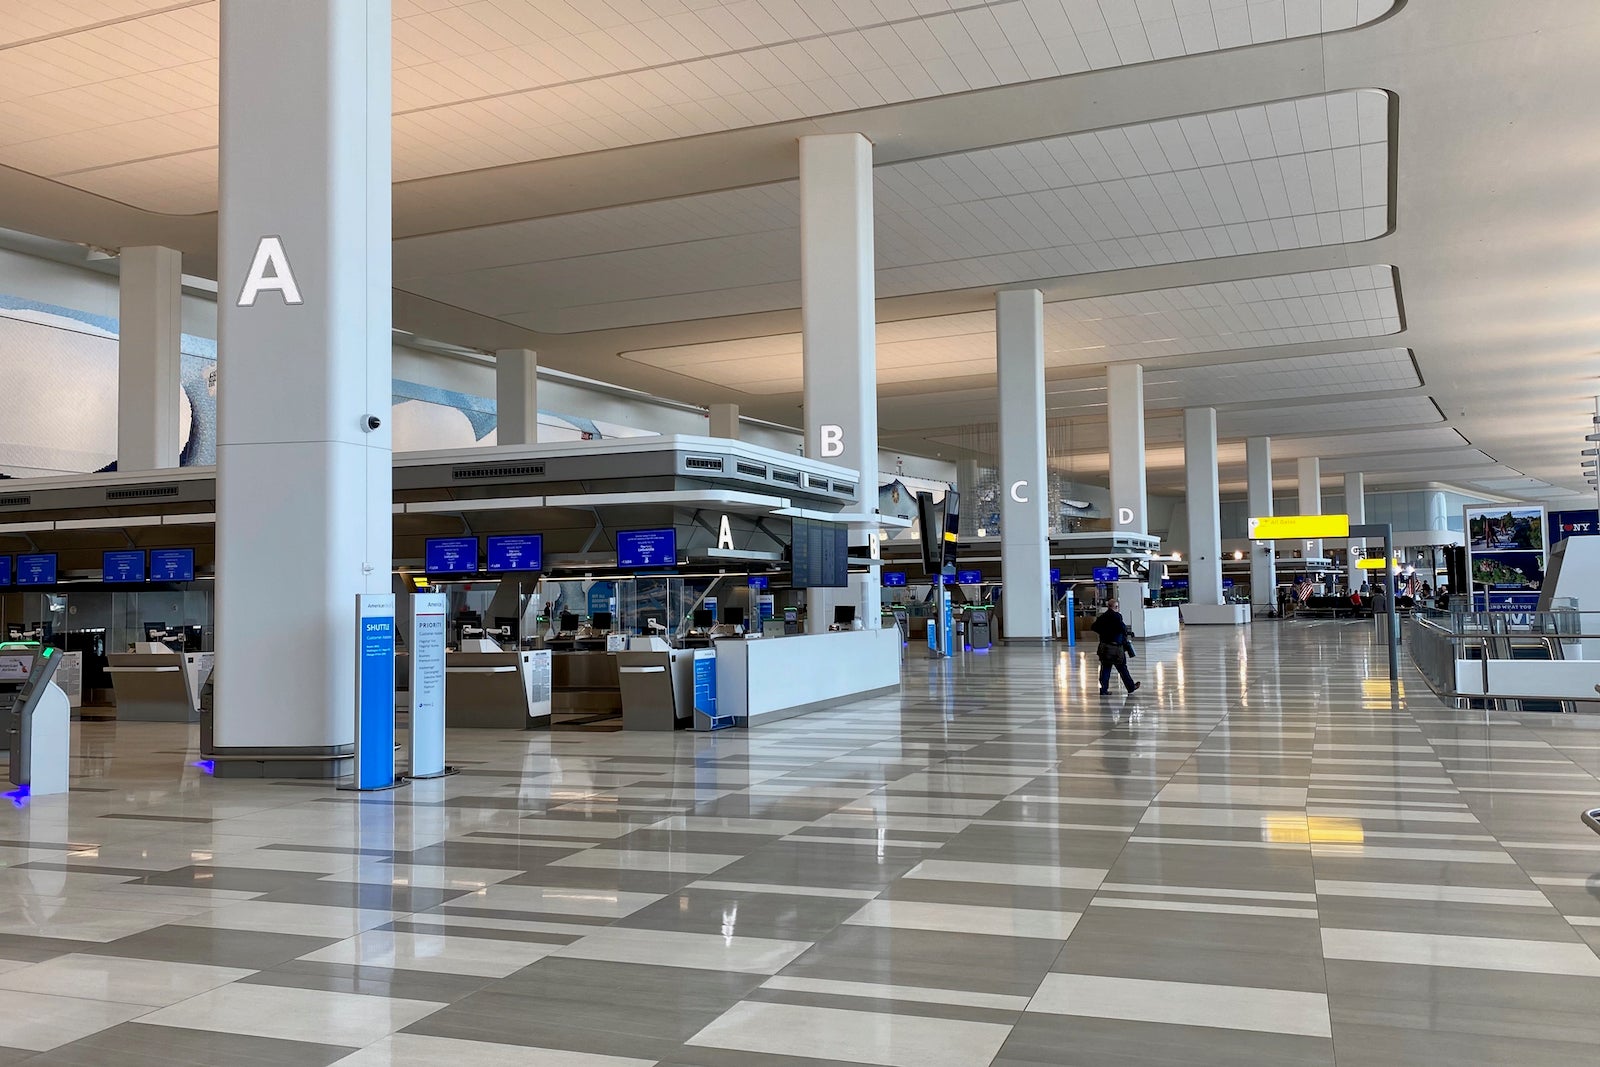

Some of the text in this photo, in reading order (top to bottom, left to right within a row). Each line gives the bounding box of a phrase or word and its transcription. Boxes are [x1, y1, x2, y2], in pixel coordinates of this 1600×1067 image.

[237, 235, 303, 306] A
[820, 425, 844, 457] B
[1010, 480, 1028, 503] C
[1118, 507, 1134, 525] D
[1572, 523, 1590, 531] NY
[718, 514, 734, 550] A
[1306, 541, 1314, 550] F
